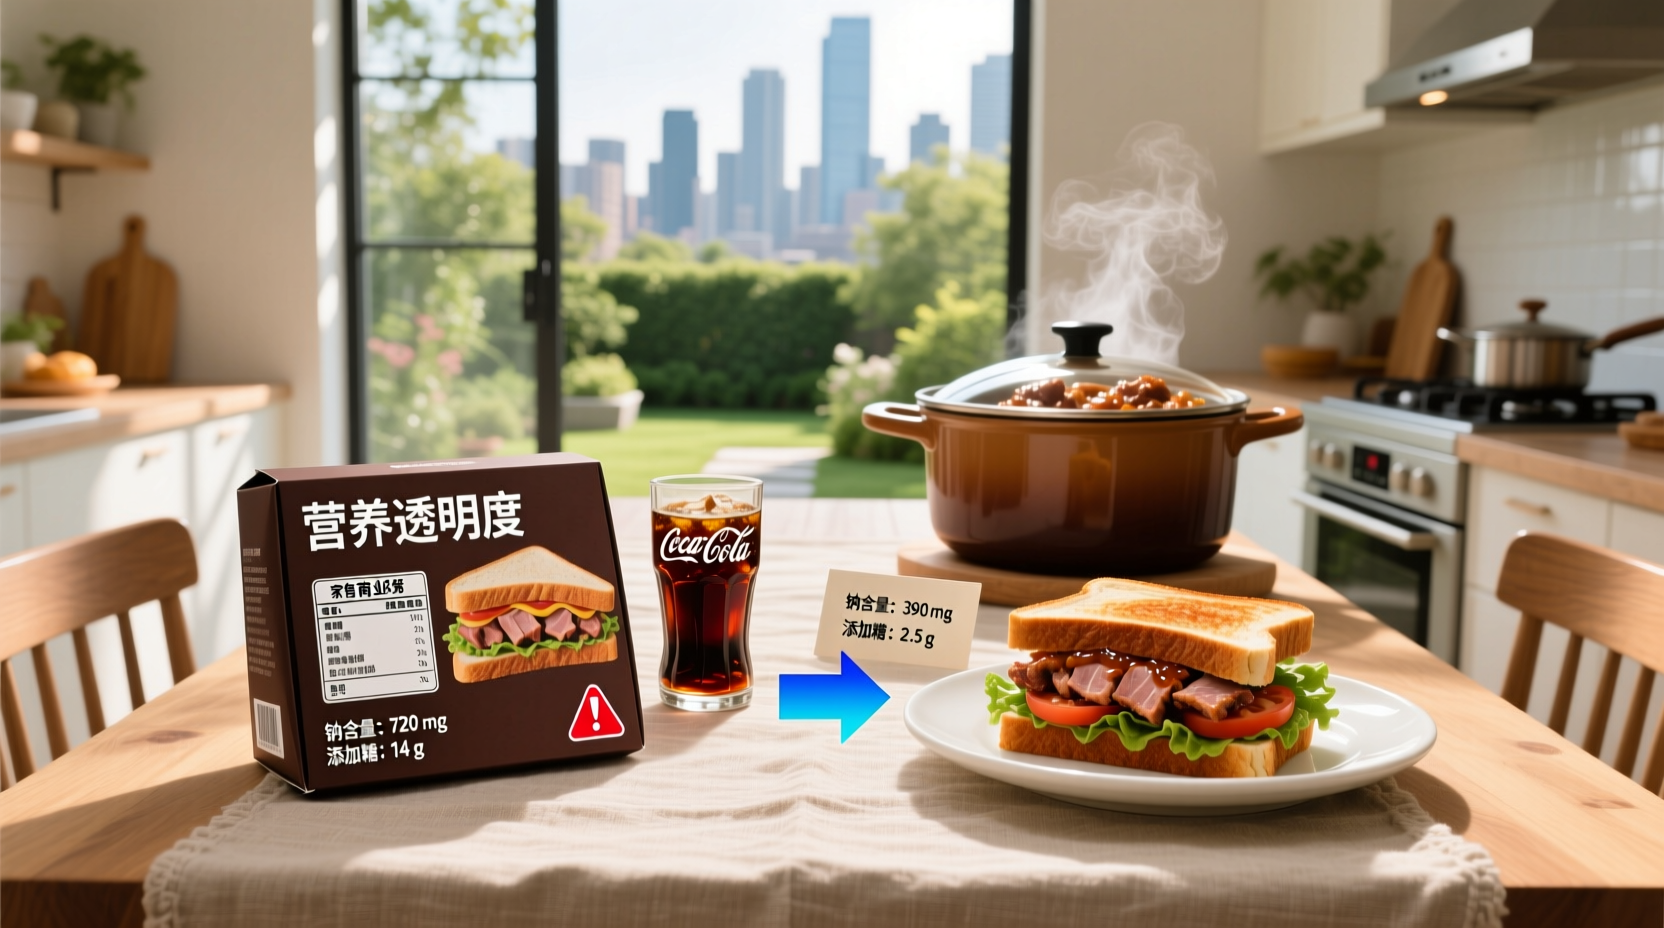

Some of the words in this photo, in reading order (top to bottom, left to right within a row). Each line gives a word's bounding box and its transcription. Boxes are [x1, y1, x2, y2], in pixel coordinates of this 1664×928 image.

[301, 490, 525, 552] 营养透明度
[660, 525, 755, 564] Coca-Cola
[902, 600, 929, 617] 390
[930, 606, 953, 624] mg
[900, 627, 923, 644] 2.5
[389, 714, 419, 734] 720
[422, 716, 448, 734] mg
[390, 739, 410, 758] 14
[413, 742, 425, 760] g
